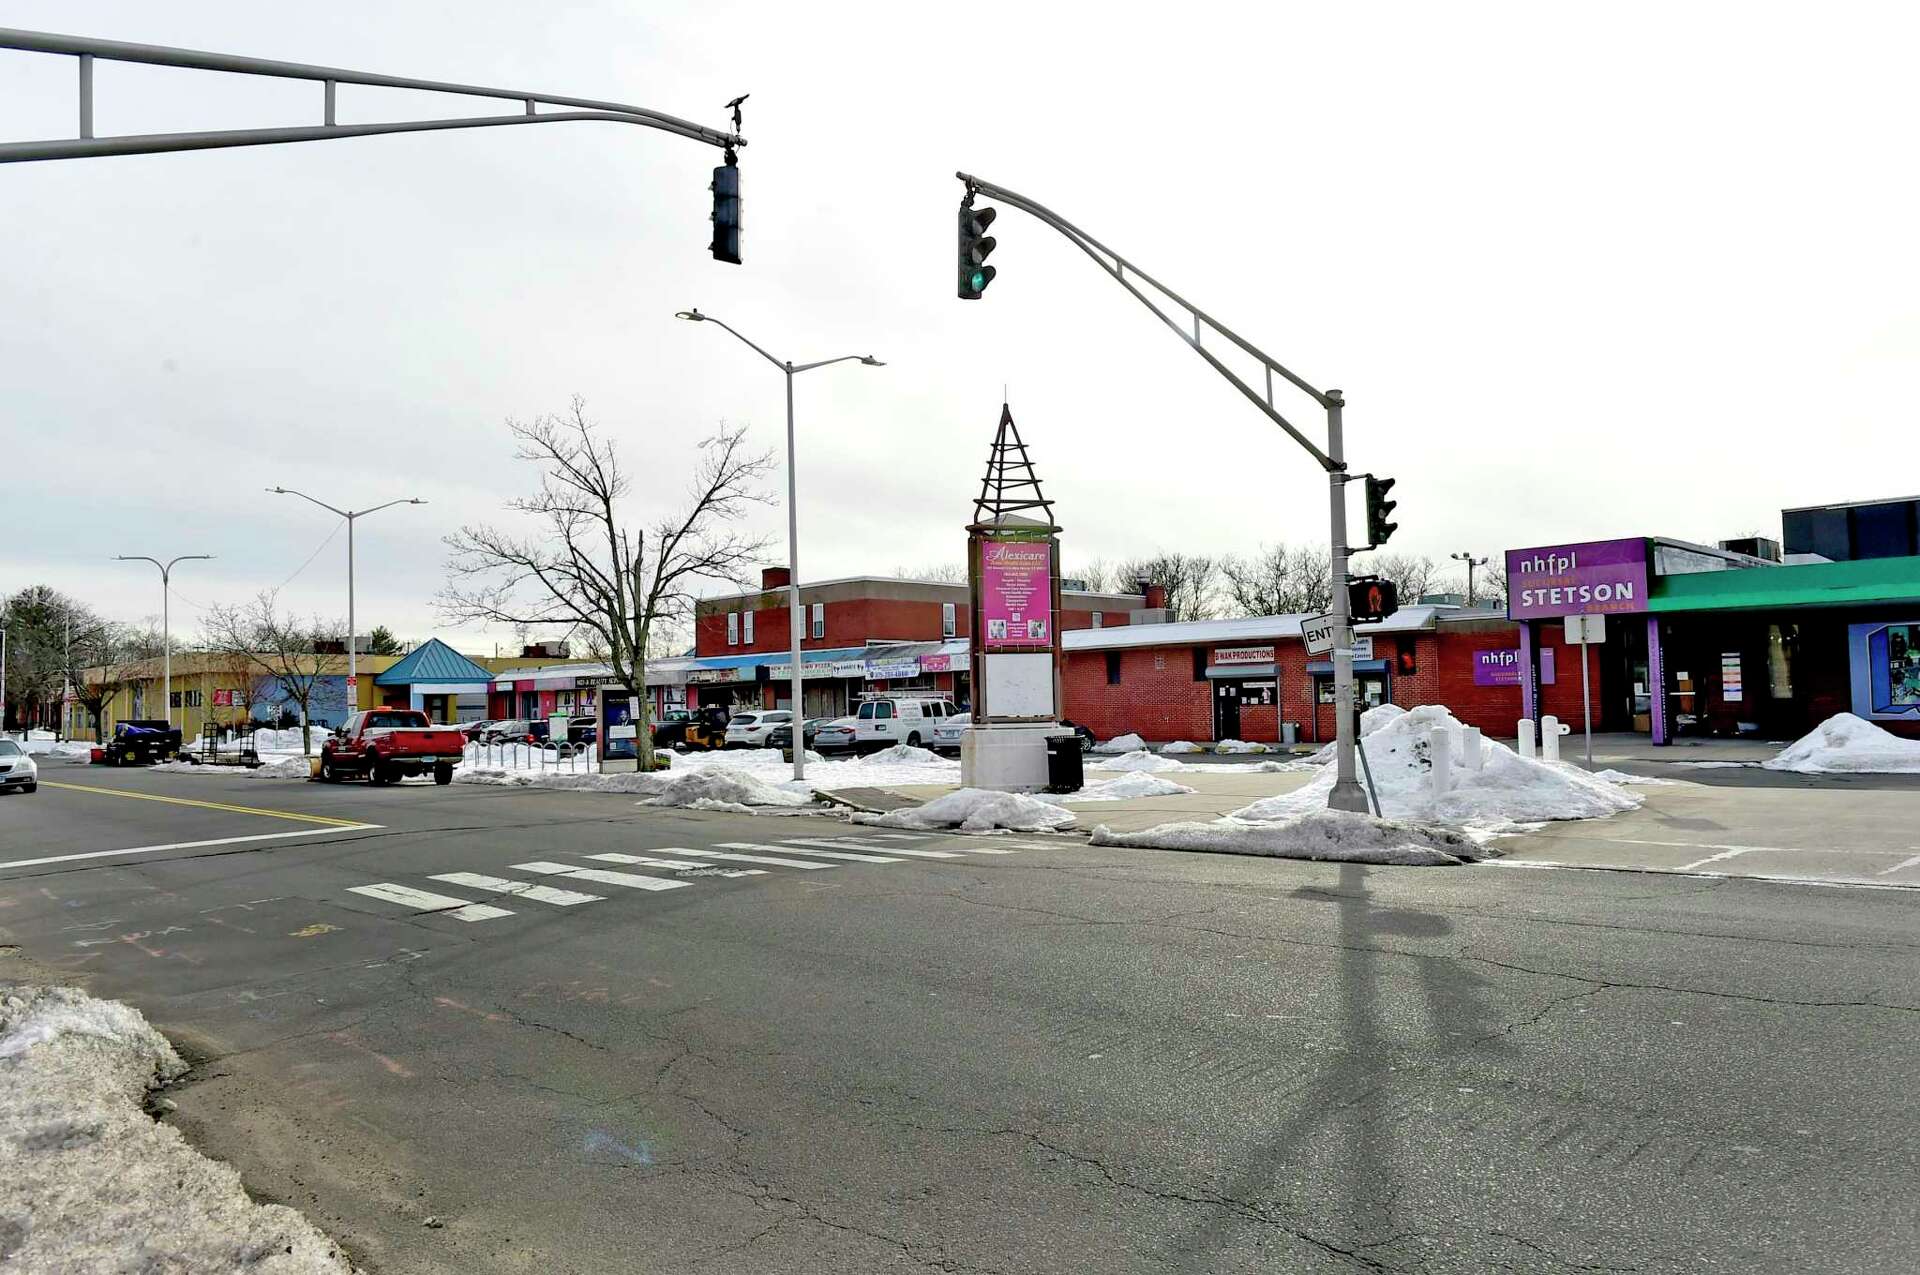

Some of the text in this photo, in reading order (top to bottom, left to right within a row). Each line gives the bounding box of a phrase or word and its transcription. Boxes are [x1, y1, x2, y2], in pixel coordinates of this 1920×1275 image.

[985, 546, 1046, 561] Alexicare
[1520, 552, 1576, 575] nhfpl
[1521, 582, 1633, 607] STETSON
[1306, 626, 1334, 643] ENT
[1232, 649, 1274, 660] PRODUCTIONS
[1482, 651, 1518, 666] nhfpl
